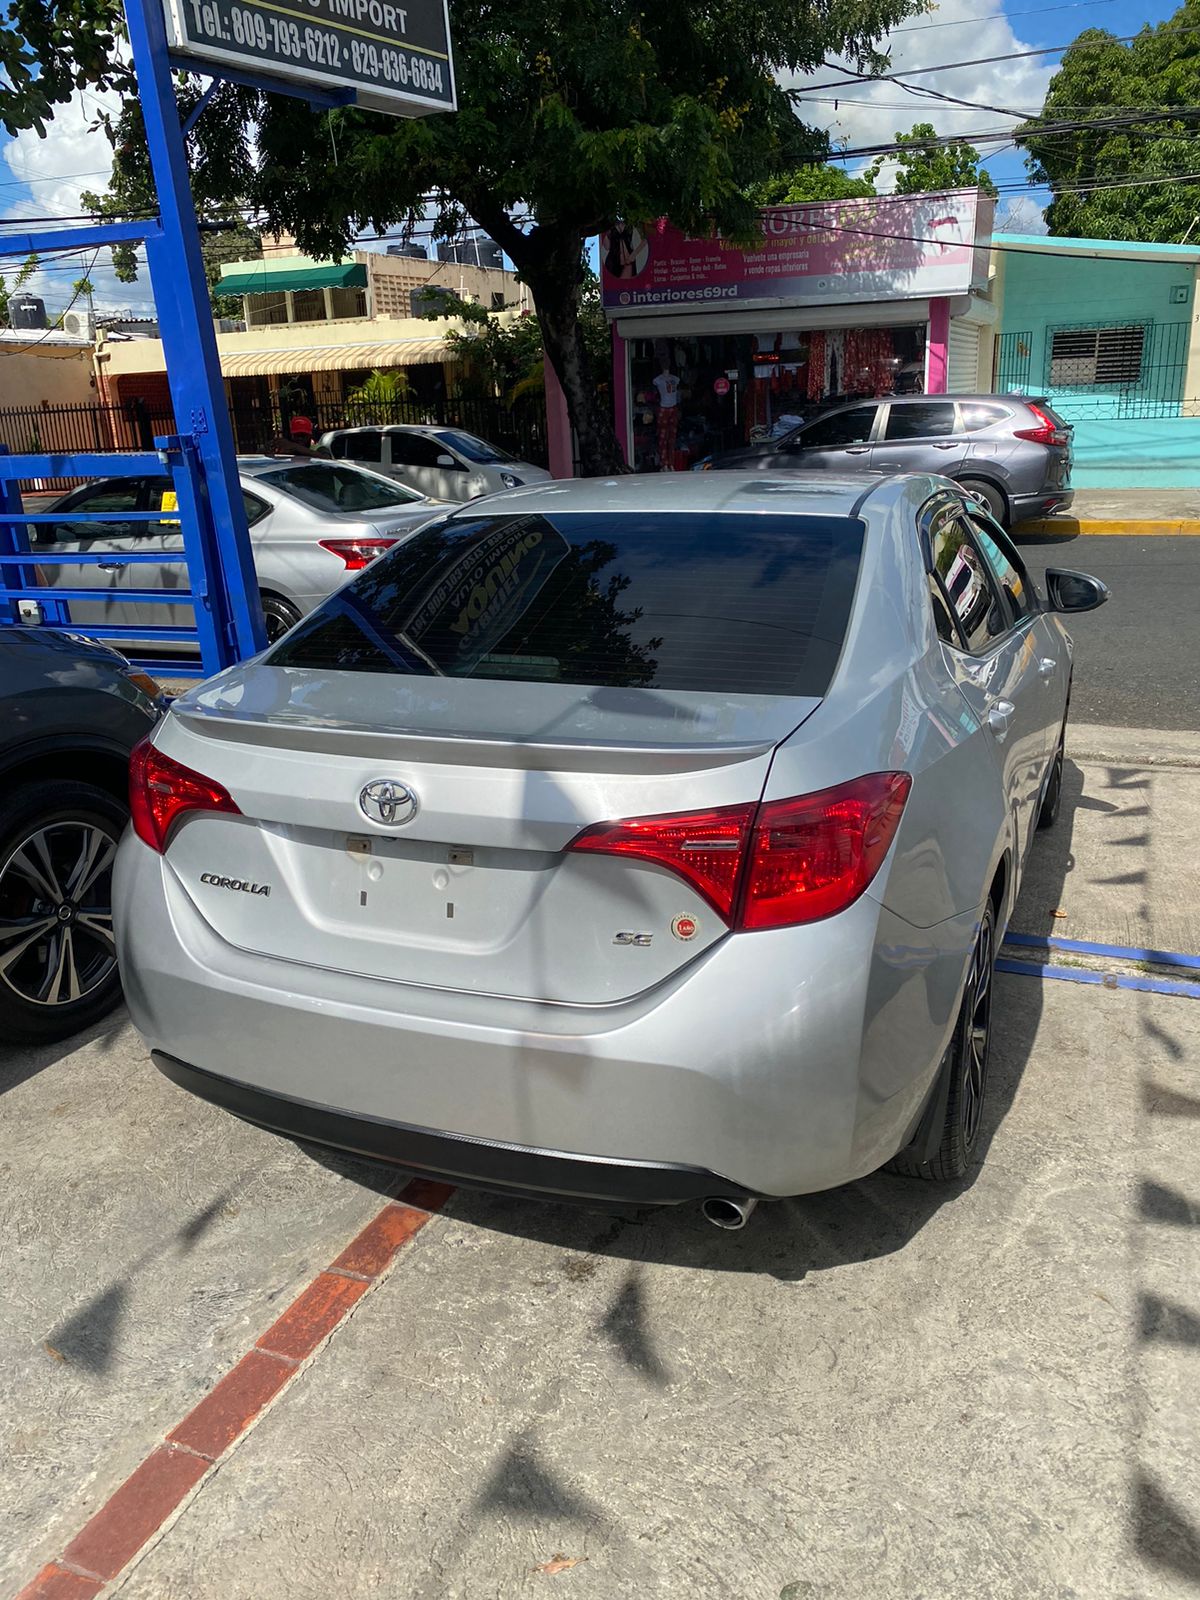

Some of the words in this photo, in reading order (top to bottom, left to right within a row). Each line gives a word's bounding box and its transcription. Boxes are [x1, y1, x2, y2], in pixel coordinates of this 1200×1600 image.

[231, 7, 341, 68] 809-793-6212
[351, 40, 443, 93] 829-836-6834
[771, 237, 798, 248] mayor
[748, 265, 765, 274] vende
[766, 265, 780, 275] ropas
[781, 262, 809, 273] interiores
[633, 284, 738, 303] interiores69rd
[200, 872, 271, 897] COROLLA
[612, 932, 654, 947] SE
